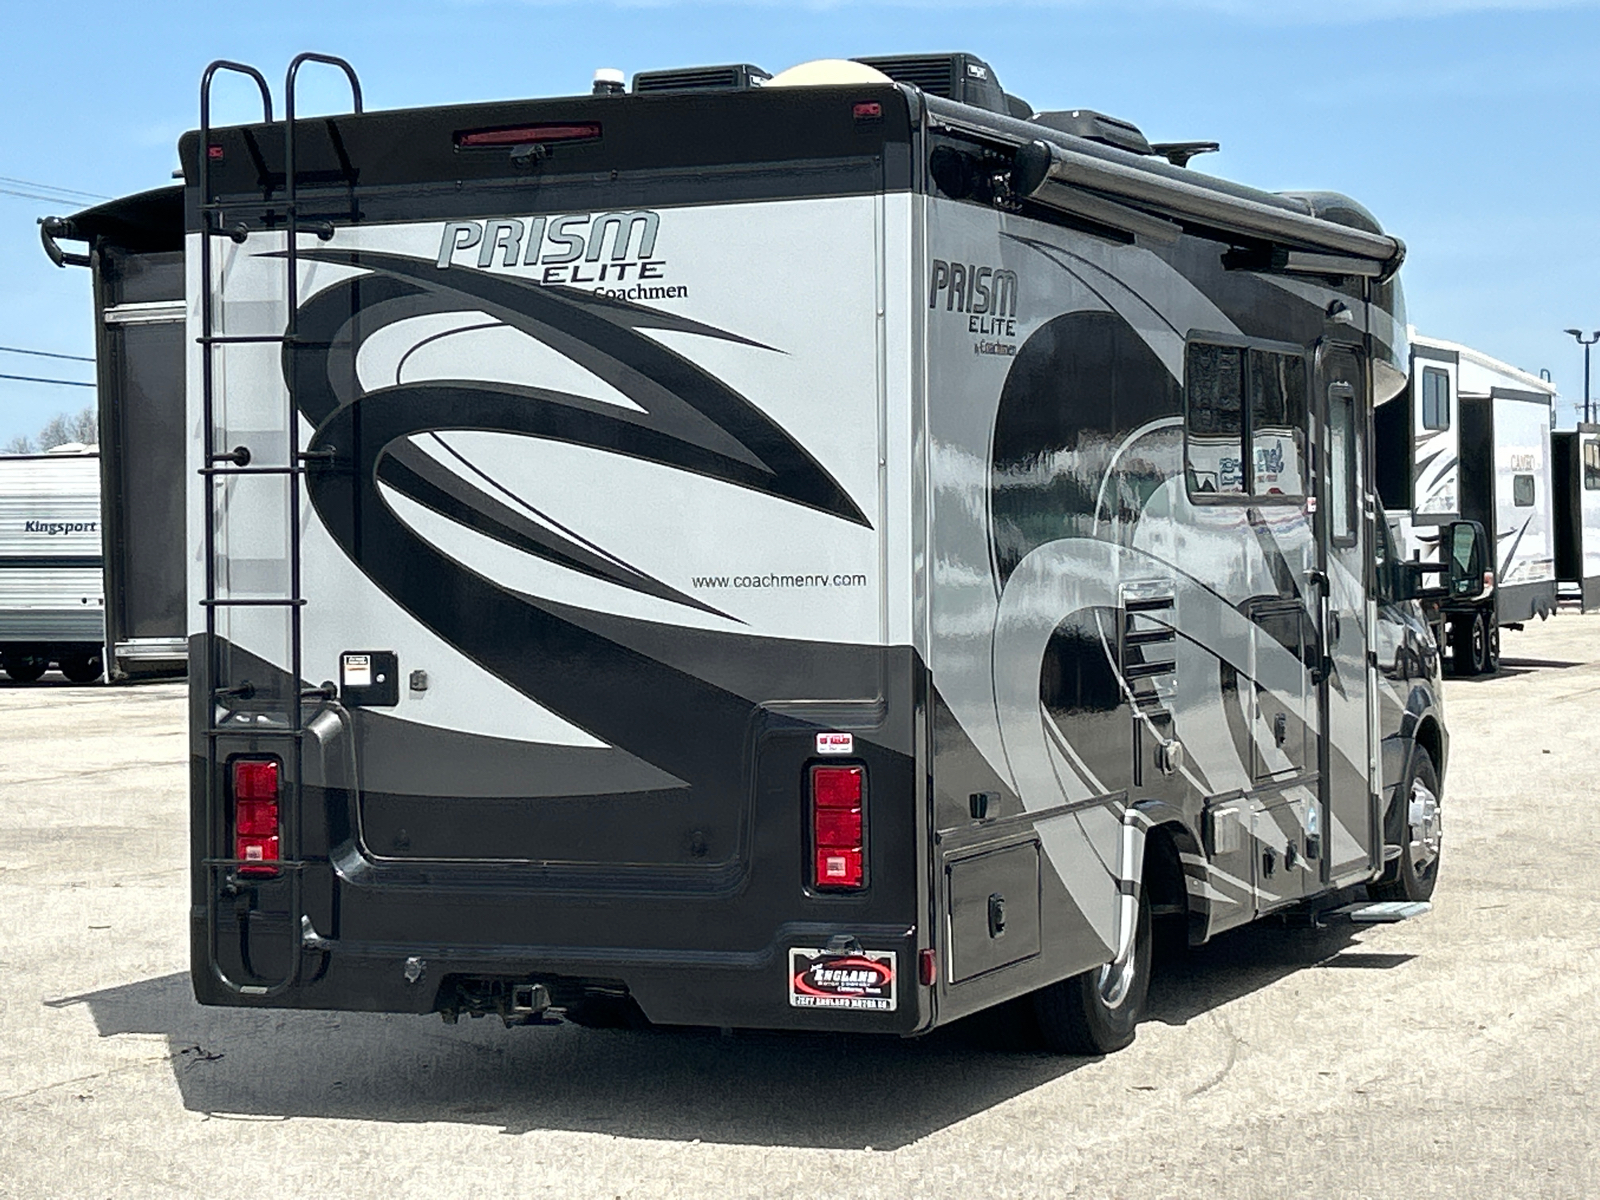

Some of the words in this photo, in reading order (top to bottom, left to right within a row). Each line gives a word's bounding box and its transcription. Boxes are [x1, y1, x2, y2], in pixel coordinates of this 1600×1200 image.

[436, 210, 660, 270] PRISM
[541, 261, 666, 285] ELITE
[594, 283, 688, 301] Coachmen
[929, 258, 1018, 317] PRISM
[968, 315, 1016, 337] ELITE
[24, 520, 97, 535] Kingsport
[692, 573, 867, 588] www.coachmenrv.com
[814, 969, 878, 983] ENGLAND
